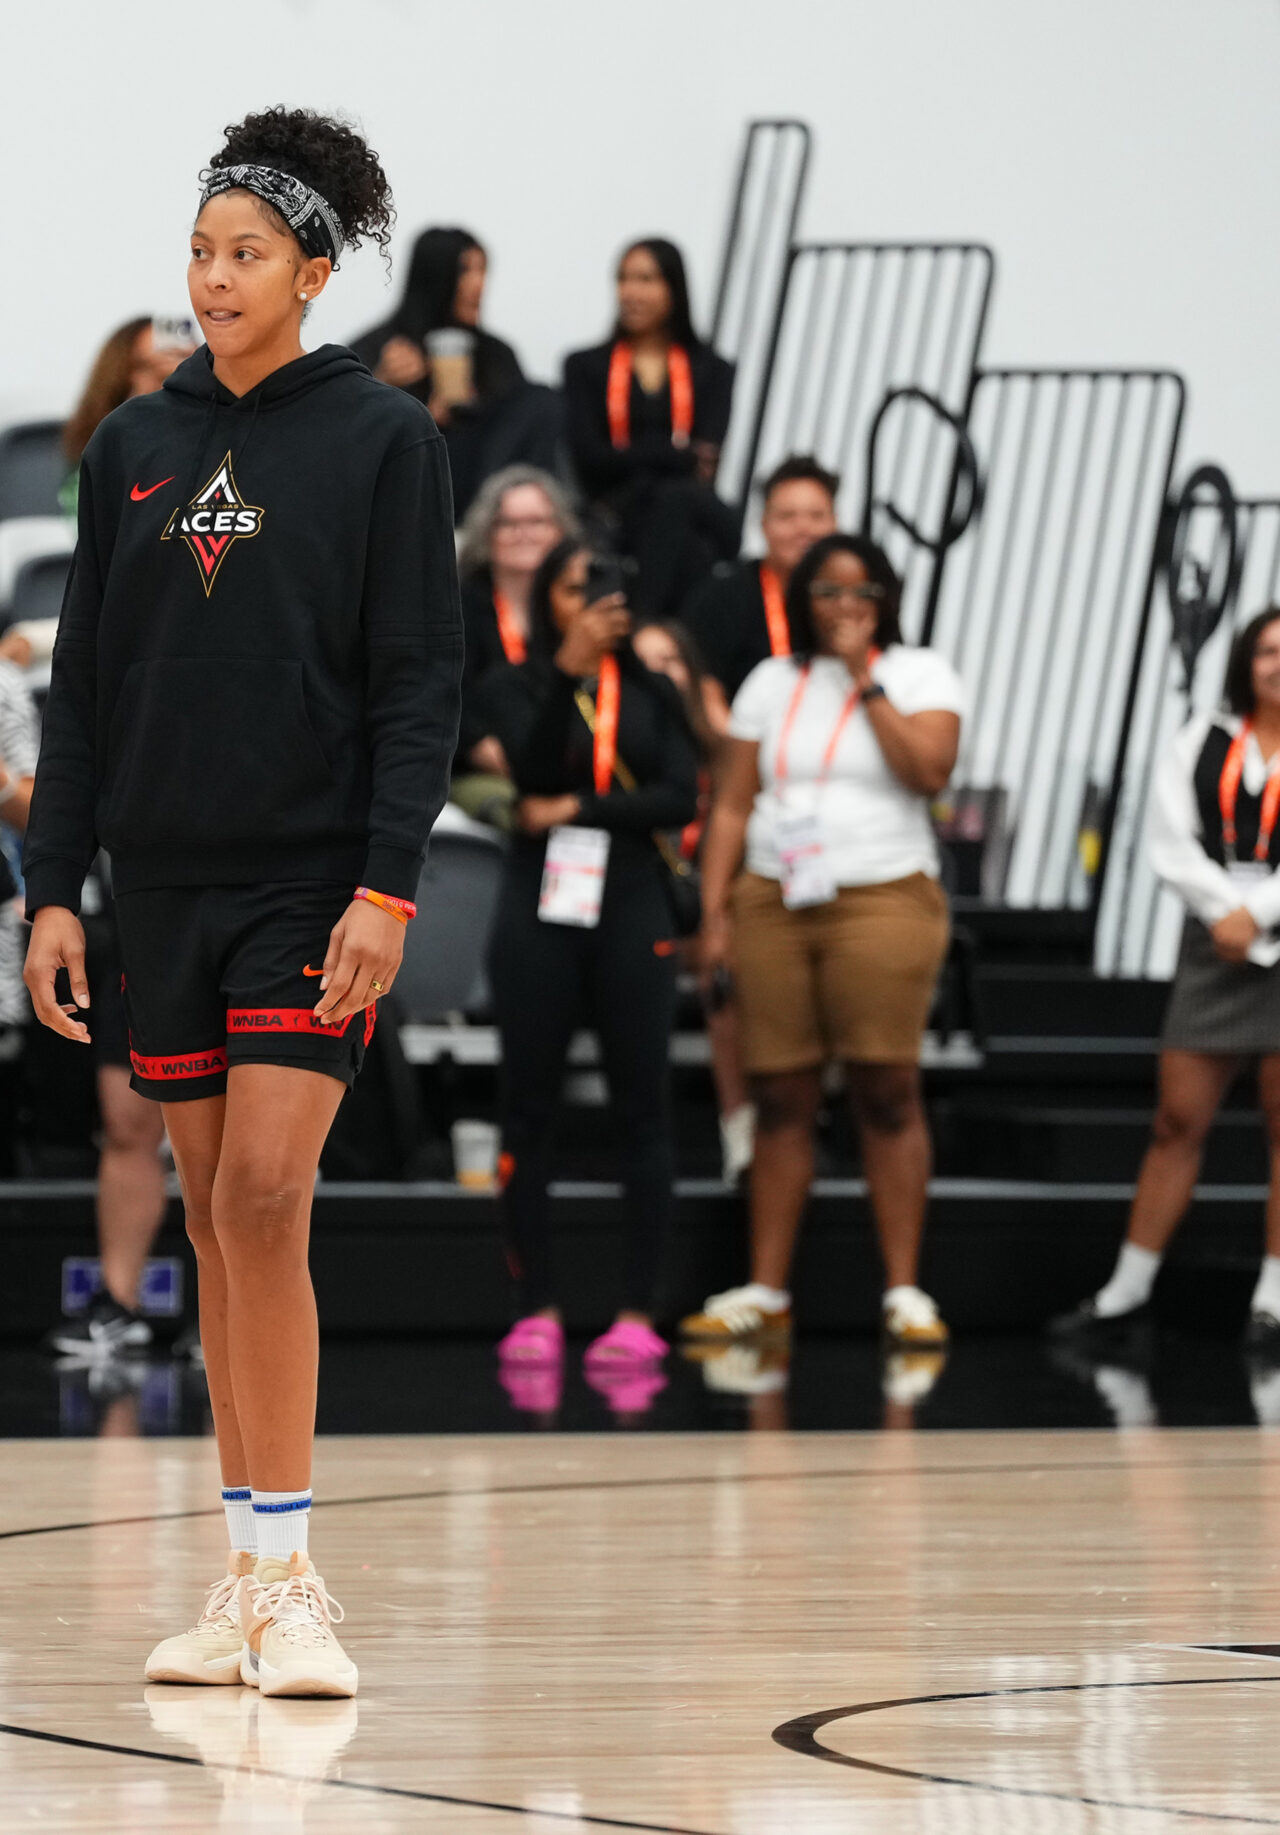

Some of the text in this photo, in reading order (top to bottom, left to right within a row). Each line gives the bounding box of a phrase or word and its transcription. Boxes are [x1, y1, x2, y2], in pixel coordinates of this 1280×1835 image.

[169, 511, 257, 533] ACES
[233, 1015, 283, 1027] WNBA
[161, 1055, 225, 1075] WNBA
